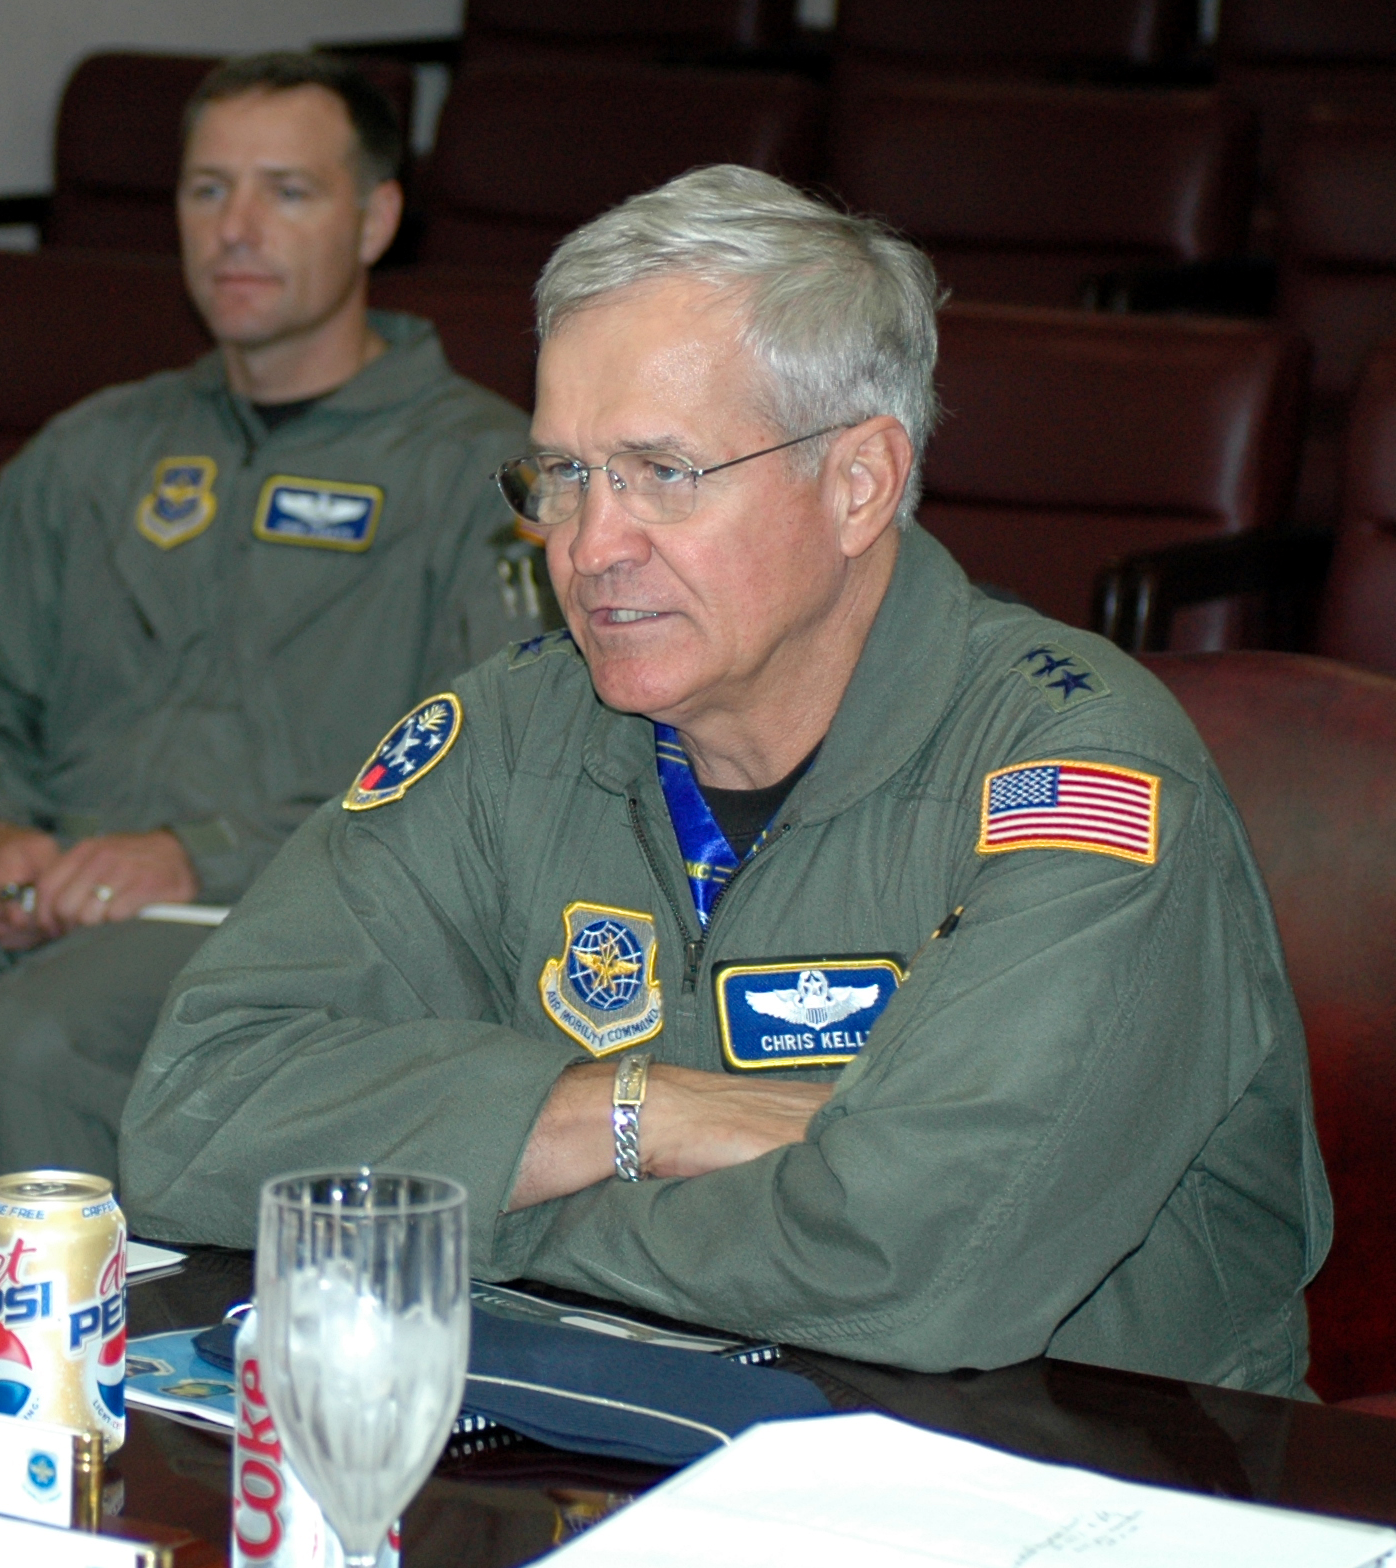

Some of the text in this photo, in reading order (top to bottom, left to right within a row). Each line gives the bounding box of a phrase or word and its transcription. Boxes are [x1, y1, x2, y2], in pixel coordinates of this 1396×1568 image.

[546, 990, 659, 1047] AIR MOBILITY COMMAND
[761, 1031, 870, 1051] CHRIS KELL
[9, 1207, 45, 1220] FREE
[234, 1358, 283, 1562] Coke
